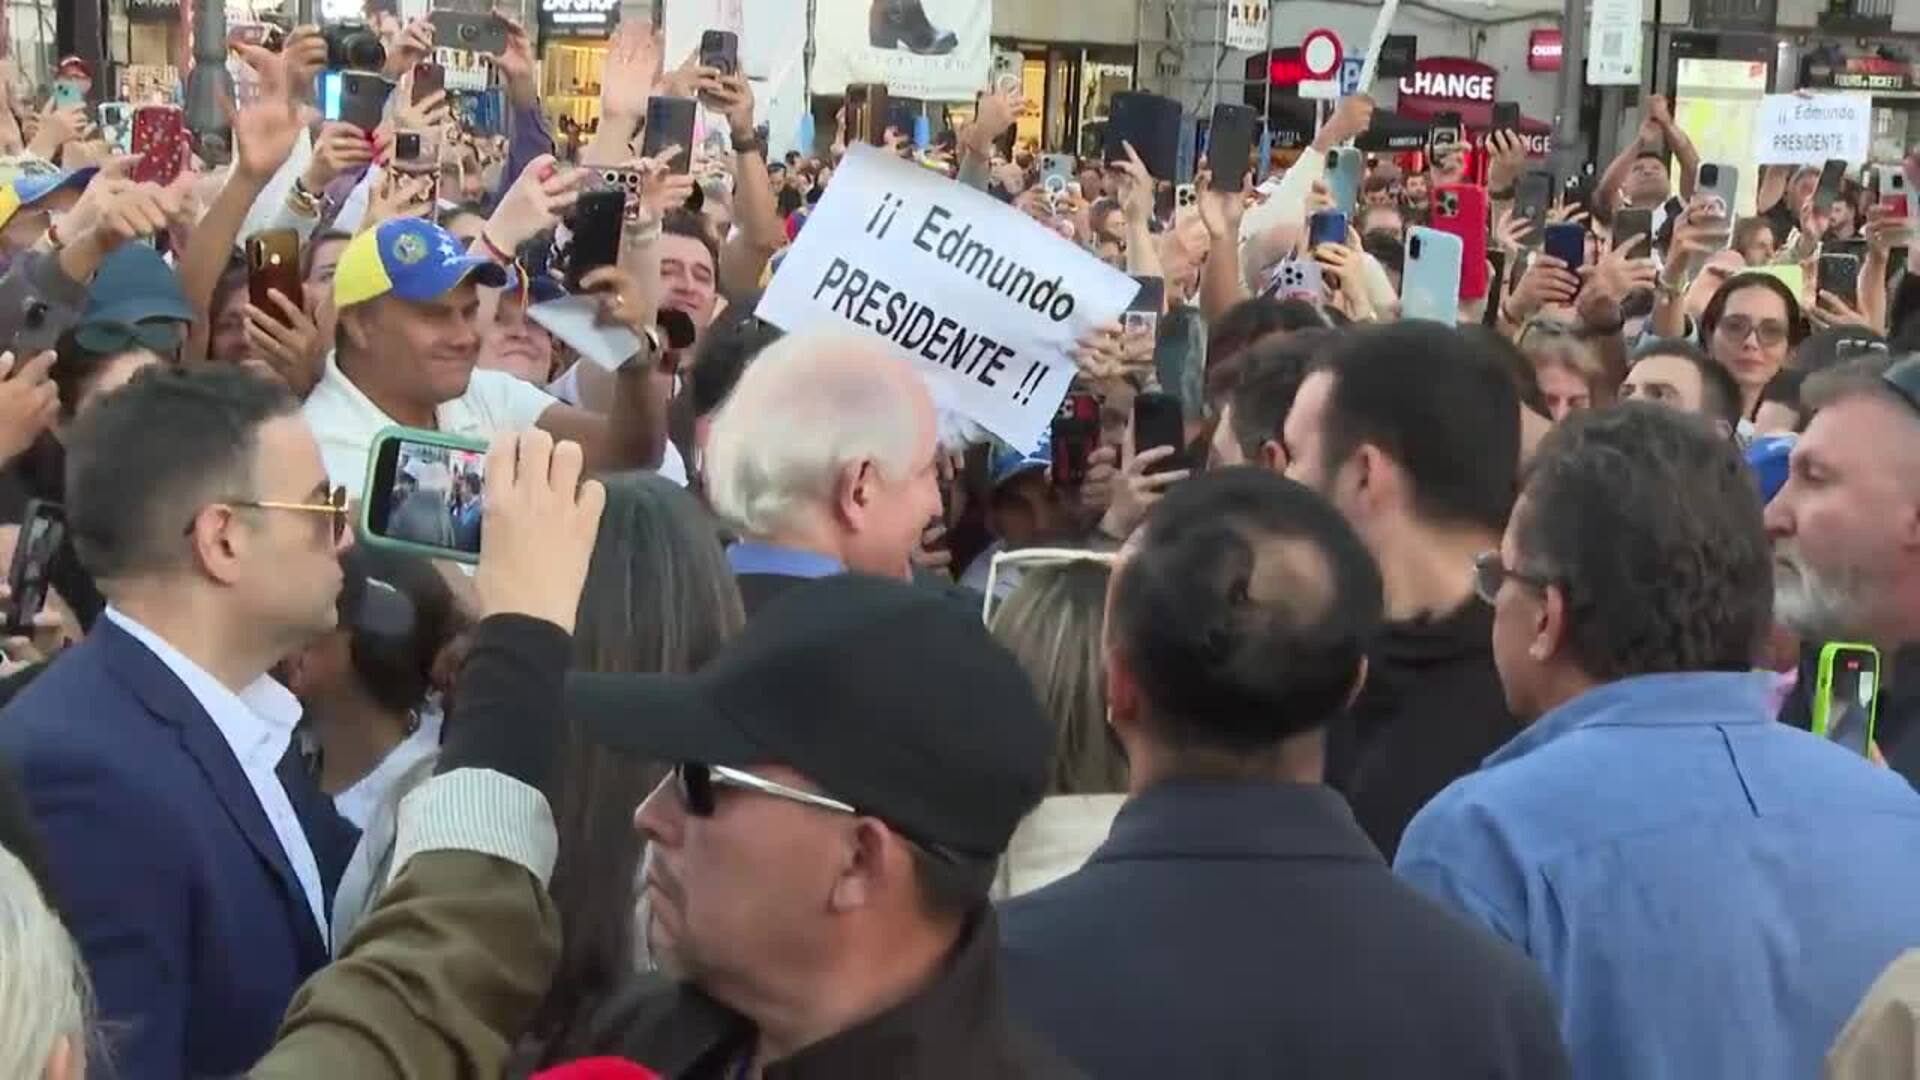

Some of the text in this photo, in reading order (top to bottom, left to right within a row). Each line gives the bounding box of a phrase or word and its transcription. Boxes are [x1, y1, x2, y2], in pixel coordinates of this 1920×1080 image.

[1400, 71, 1493, 100] CHANGE
[1794, 103, 1855, 121] Edmundo
[1773, 133, 1843, 151] PRESIDENTE
[912, 204, 1075, 322] Edmundo
[812, 257, 1051, 406] PRESIDENTE !!
